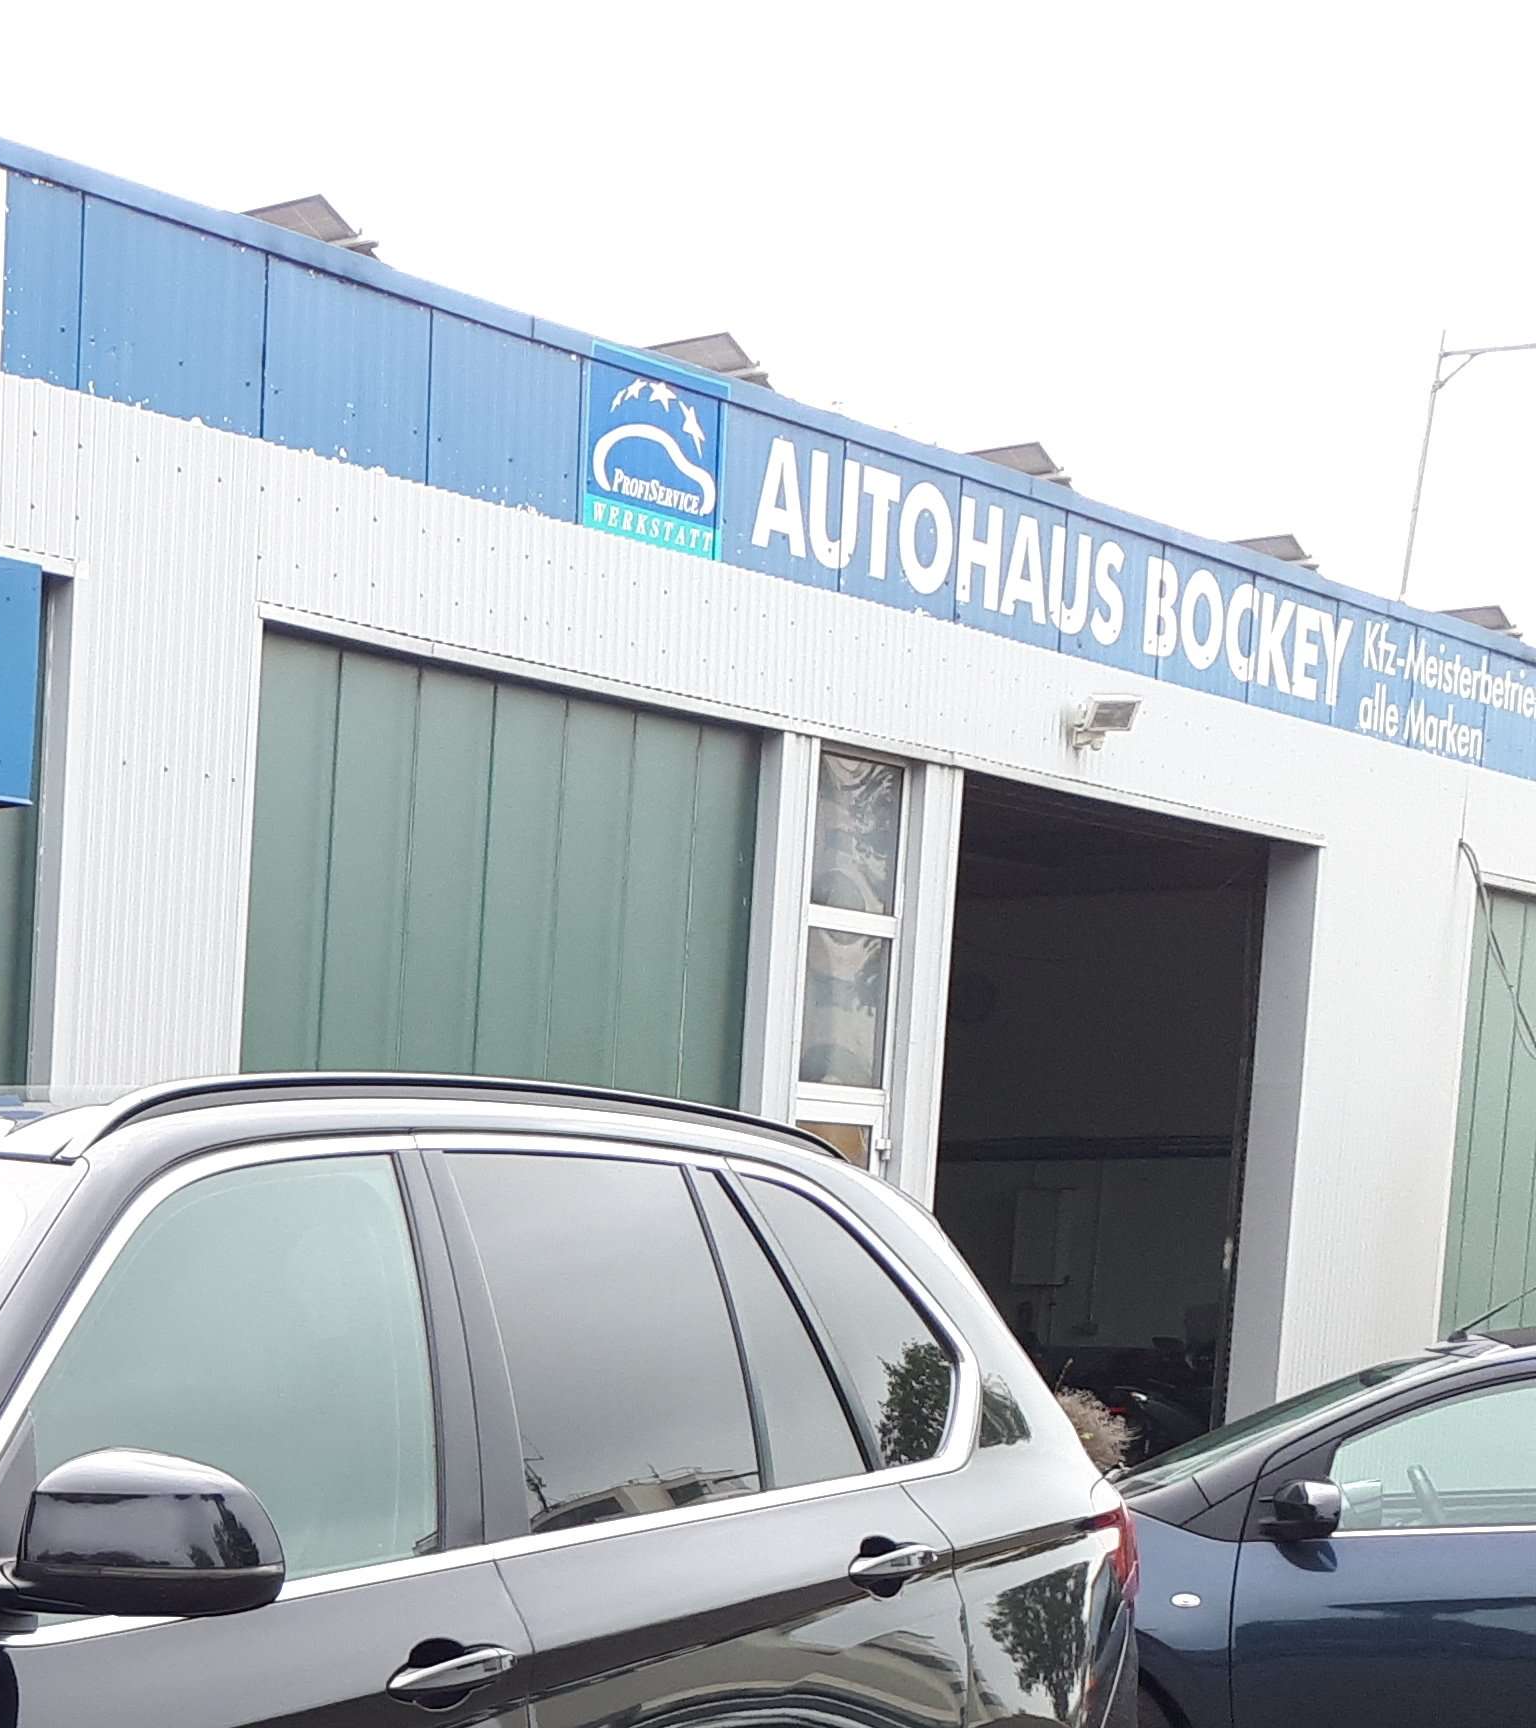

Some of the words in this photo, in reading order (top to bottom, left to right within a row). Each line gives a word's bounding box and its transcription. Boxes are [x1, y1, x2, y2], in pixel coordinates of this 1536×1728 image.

[593, 501, 712, 553] WERKSTATT
[752, 435, 1125, 645] AUTOHAUS
[1142, 555, 1354, 708] BOCKEY
[1363, 620, 1536, 721] Kfz-Meisterbetrie
[1359, 682, 1399, 737] alle
[1403, 698, 1483, 760] Marken
